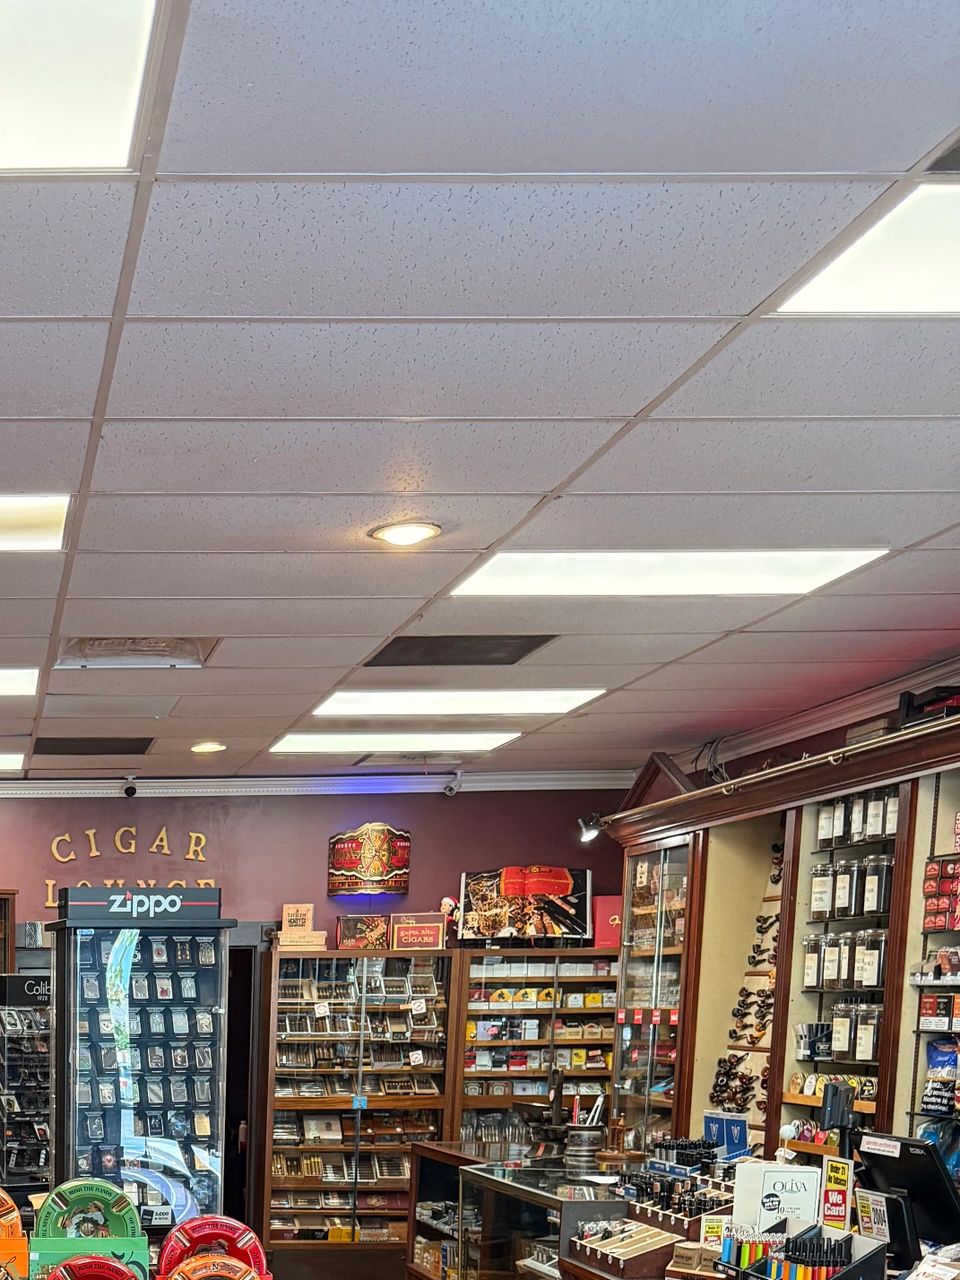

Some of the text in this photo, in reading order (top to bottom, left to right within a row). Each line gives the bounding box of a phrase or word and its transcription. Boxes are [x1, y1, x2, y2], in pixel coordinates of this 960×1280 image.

[51, 826, 207, 863] CIGAR
[95, 1186, 113, 1197] HANDS
[828, 1191, 843, 1203] We
[824, 1203, 845, 1216] Card
